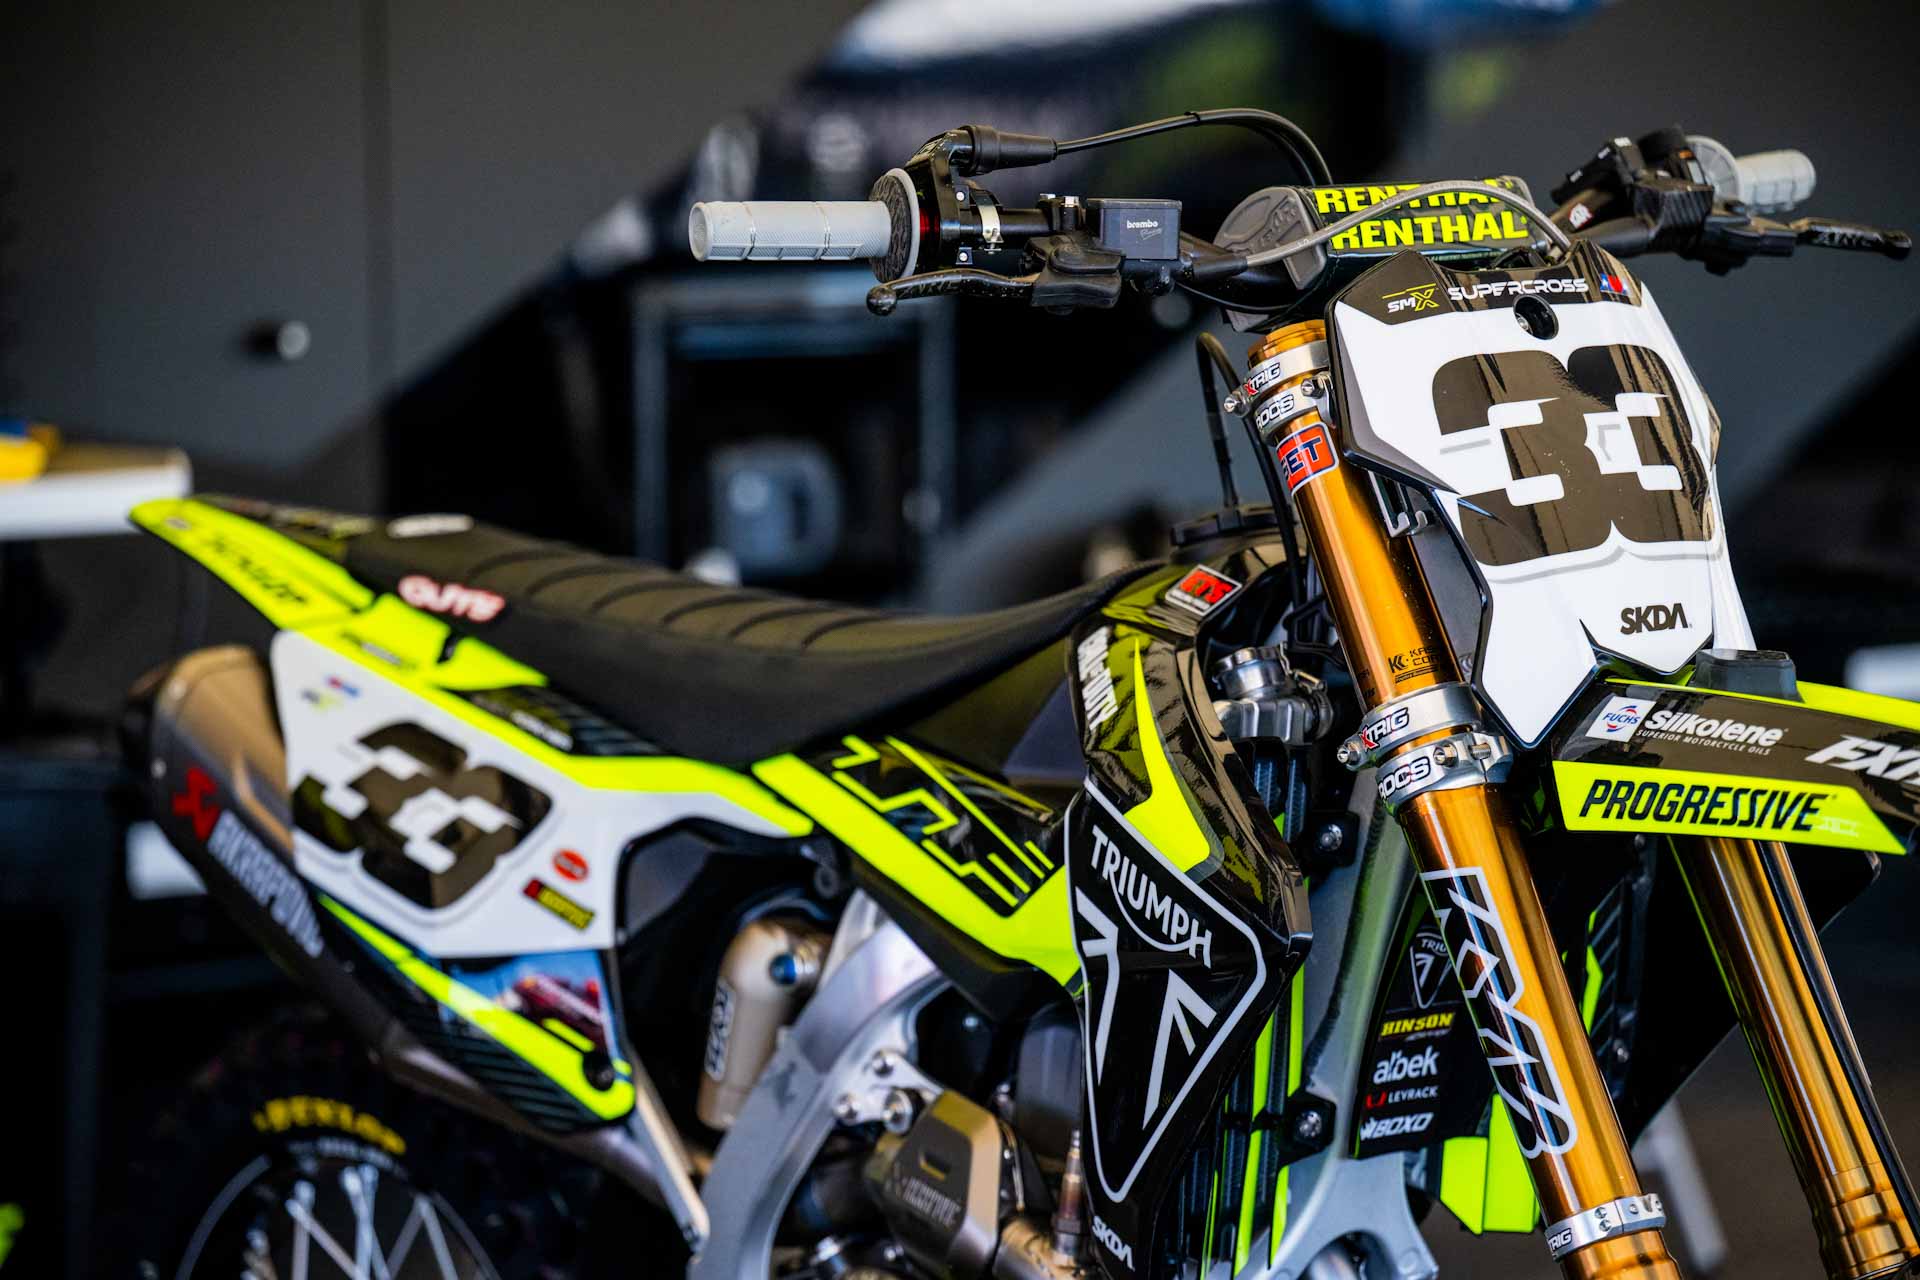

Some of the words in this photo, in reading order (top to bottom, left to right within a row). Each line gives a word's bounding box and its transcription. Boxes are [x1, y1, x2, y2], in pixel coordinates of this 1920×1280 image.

[1126, 218, 1159, 230] brembo
[1329, 211, 1529, 250] RENTHAL
[1387, 288, 1440, 313] SMX
[1448, 278, 1589, 301] SUPERCROSS
[1243, 362, 1281, 396] XTRIG
[1432, 344, 1714, 566] 33
[1620, 603, 1688, 635] SKDA
[1359, 707, 1410, 750] XTRIG
[1602, 712, 1641, 725] FUCHS
[1645, 709, 1785, 747] Silkolene
[1635, 728, 1680, 742] SUPERIOR
[1682, 735, 1746, 752] MOTORCYCLE
[1747, 745, 1771, 756] OILS
[1579, 779, 1829, 832] PROGRESSIVE
[1091, 824, 1212, 969] TRIUMPH
[1421, 938, 1447, 953] TRIU
[1381, 1012, 1454, 1037] HINSON
[1388, 1085, 1438, 1104] LEVRACK
